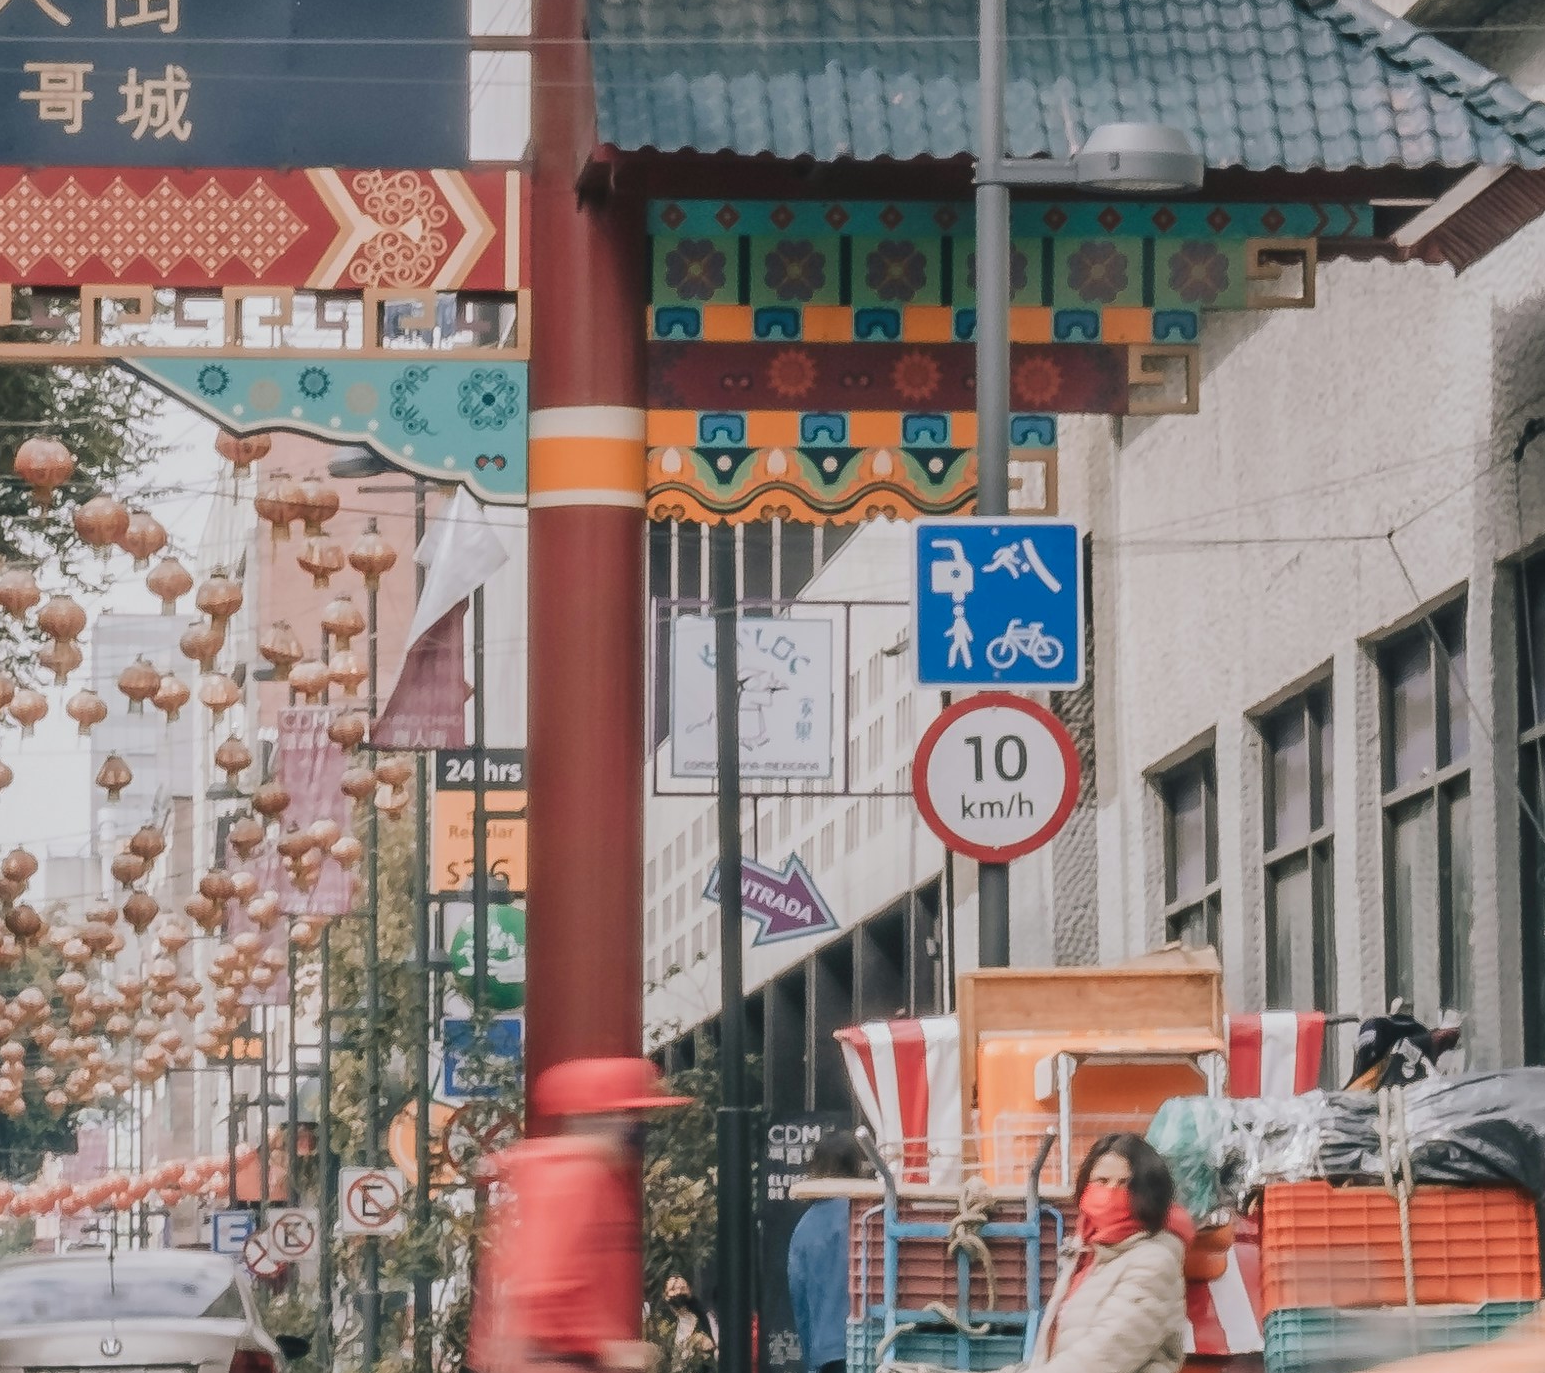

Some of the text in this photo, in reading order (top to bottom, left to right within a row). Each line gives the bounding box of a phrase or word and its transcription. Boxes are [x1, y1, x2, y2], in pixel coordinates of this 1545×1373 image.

[445, 757, 522, 783] 24 hrs
[964, 734, 1028, 782] 10
[961, 792, 1034, 819] km/h
[740, 877, 812, 925] NTRADA
[768, 1124, 829, 1145] CDM
